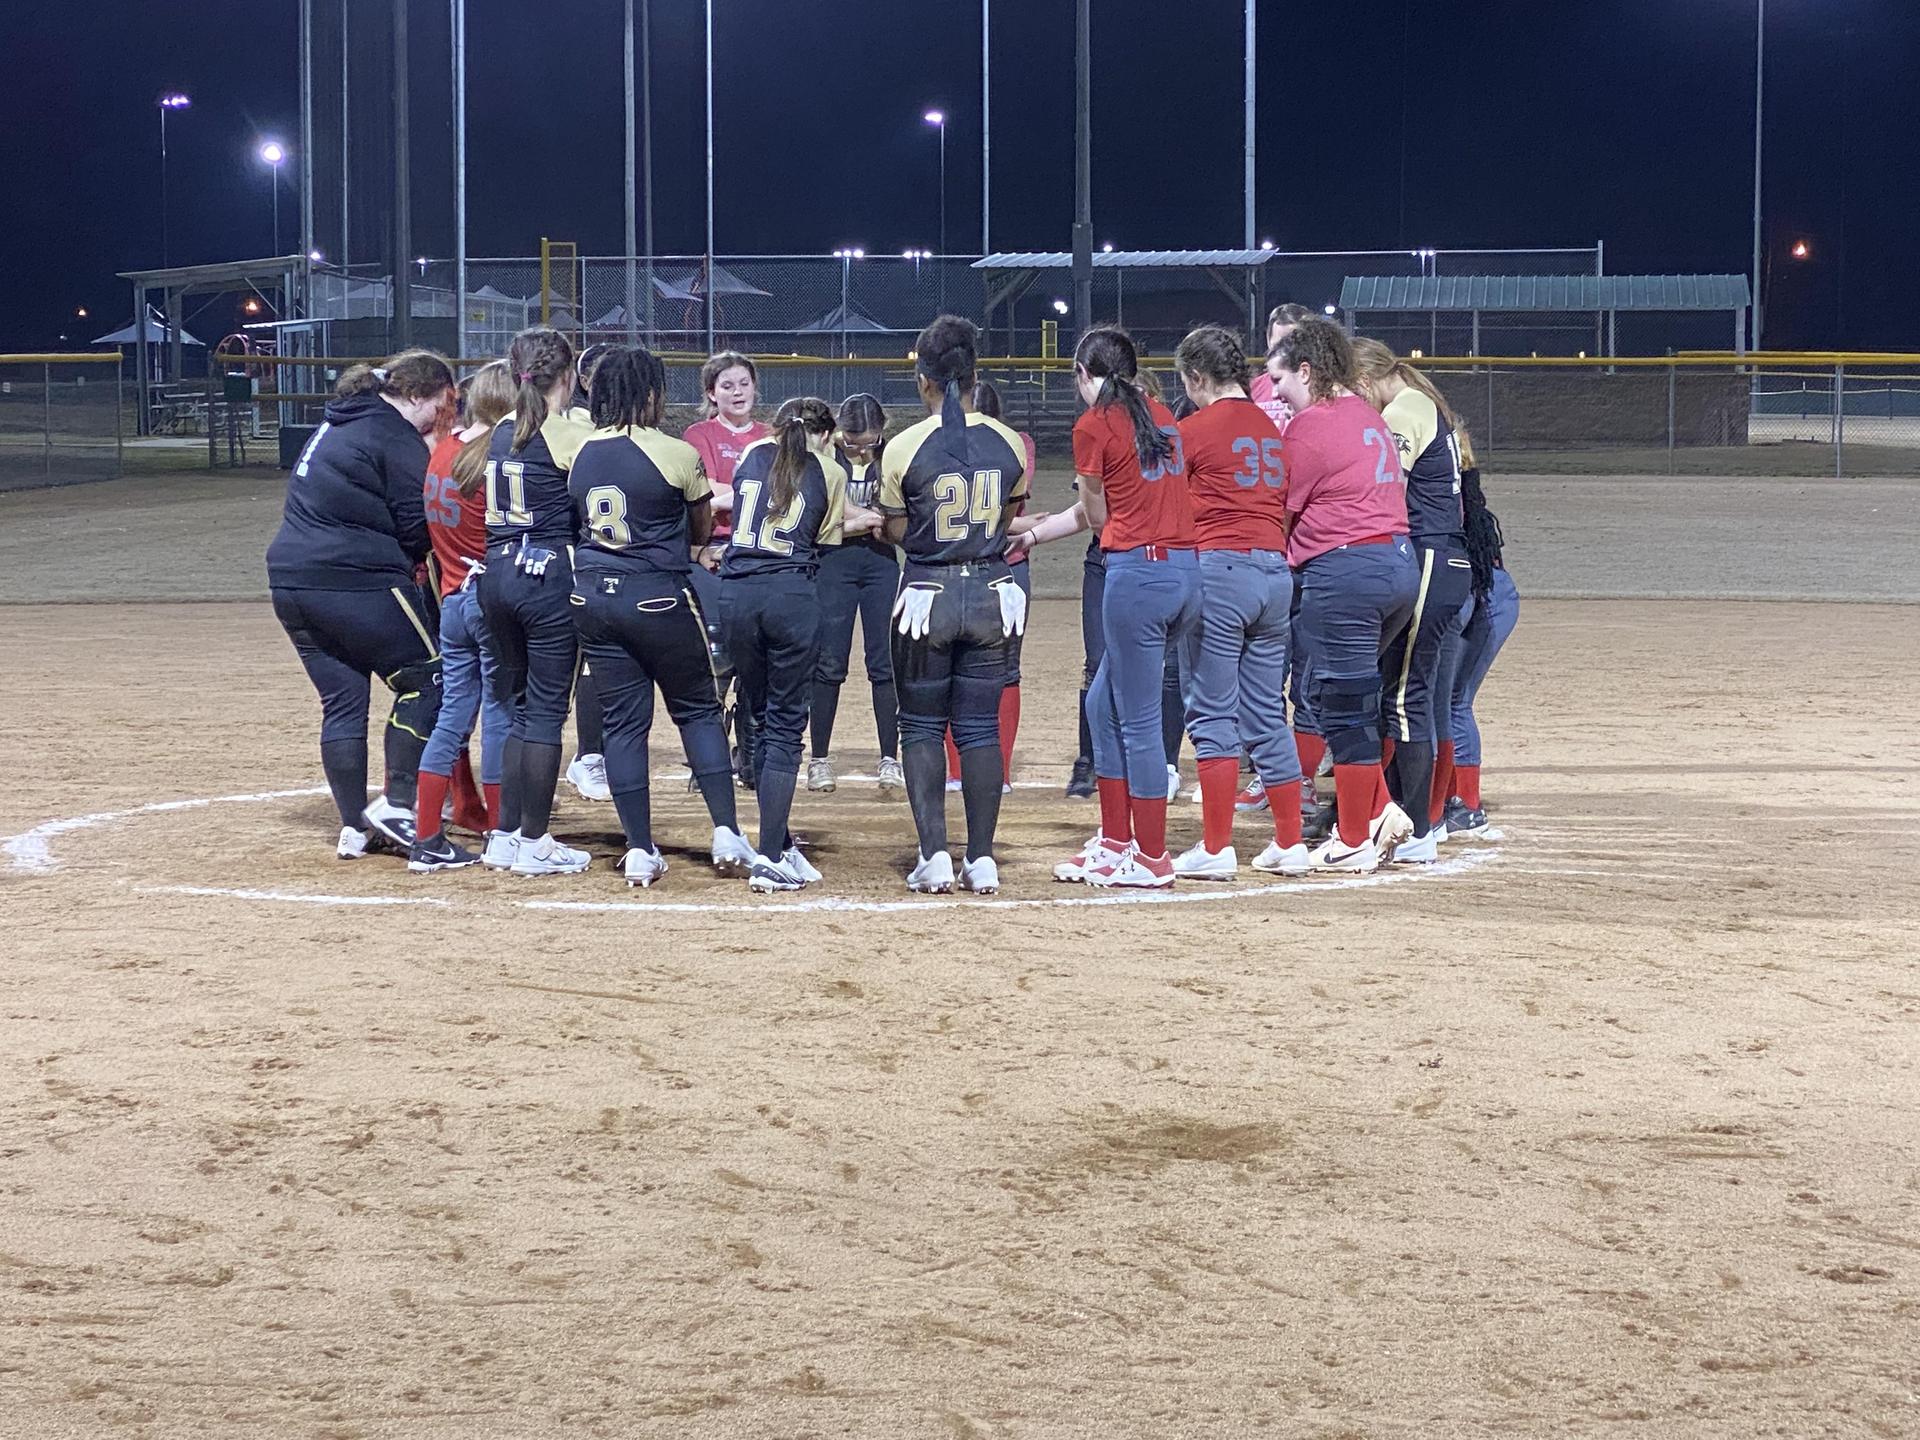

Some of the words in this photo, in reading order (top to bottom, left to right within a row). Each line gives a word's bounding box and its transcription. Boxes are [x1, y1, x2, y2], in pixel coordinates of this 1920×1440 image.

[484, 460, 534, 526] 11
[1231, 437, 1284, 489] 35
[1446, 429, 1462, 495] 1
[586, 485, 632, 549] 8
[732, 479, 806, 557] 12
[934, 469, 1002, 542] 24
